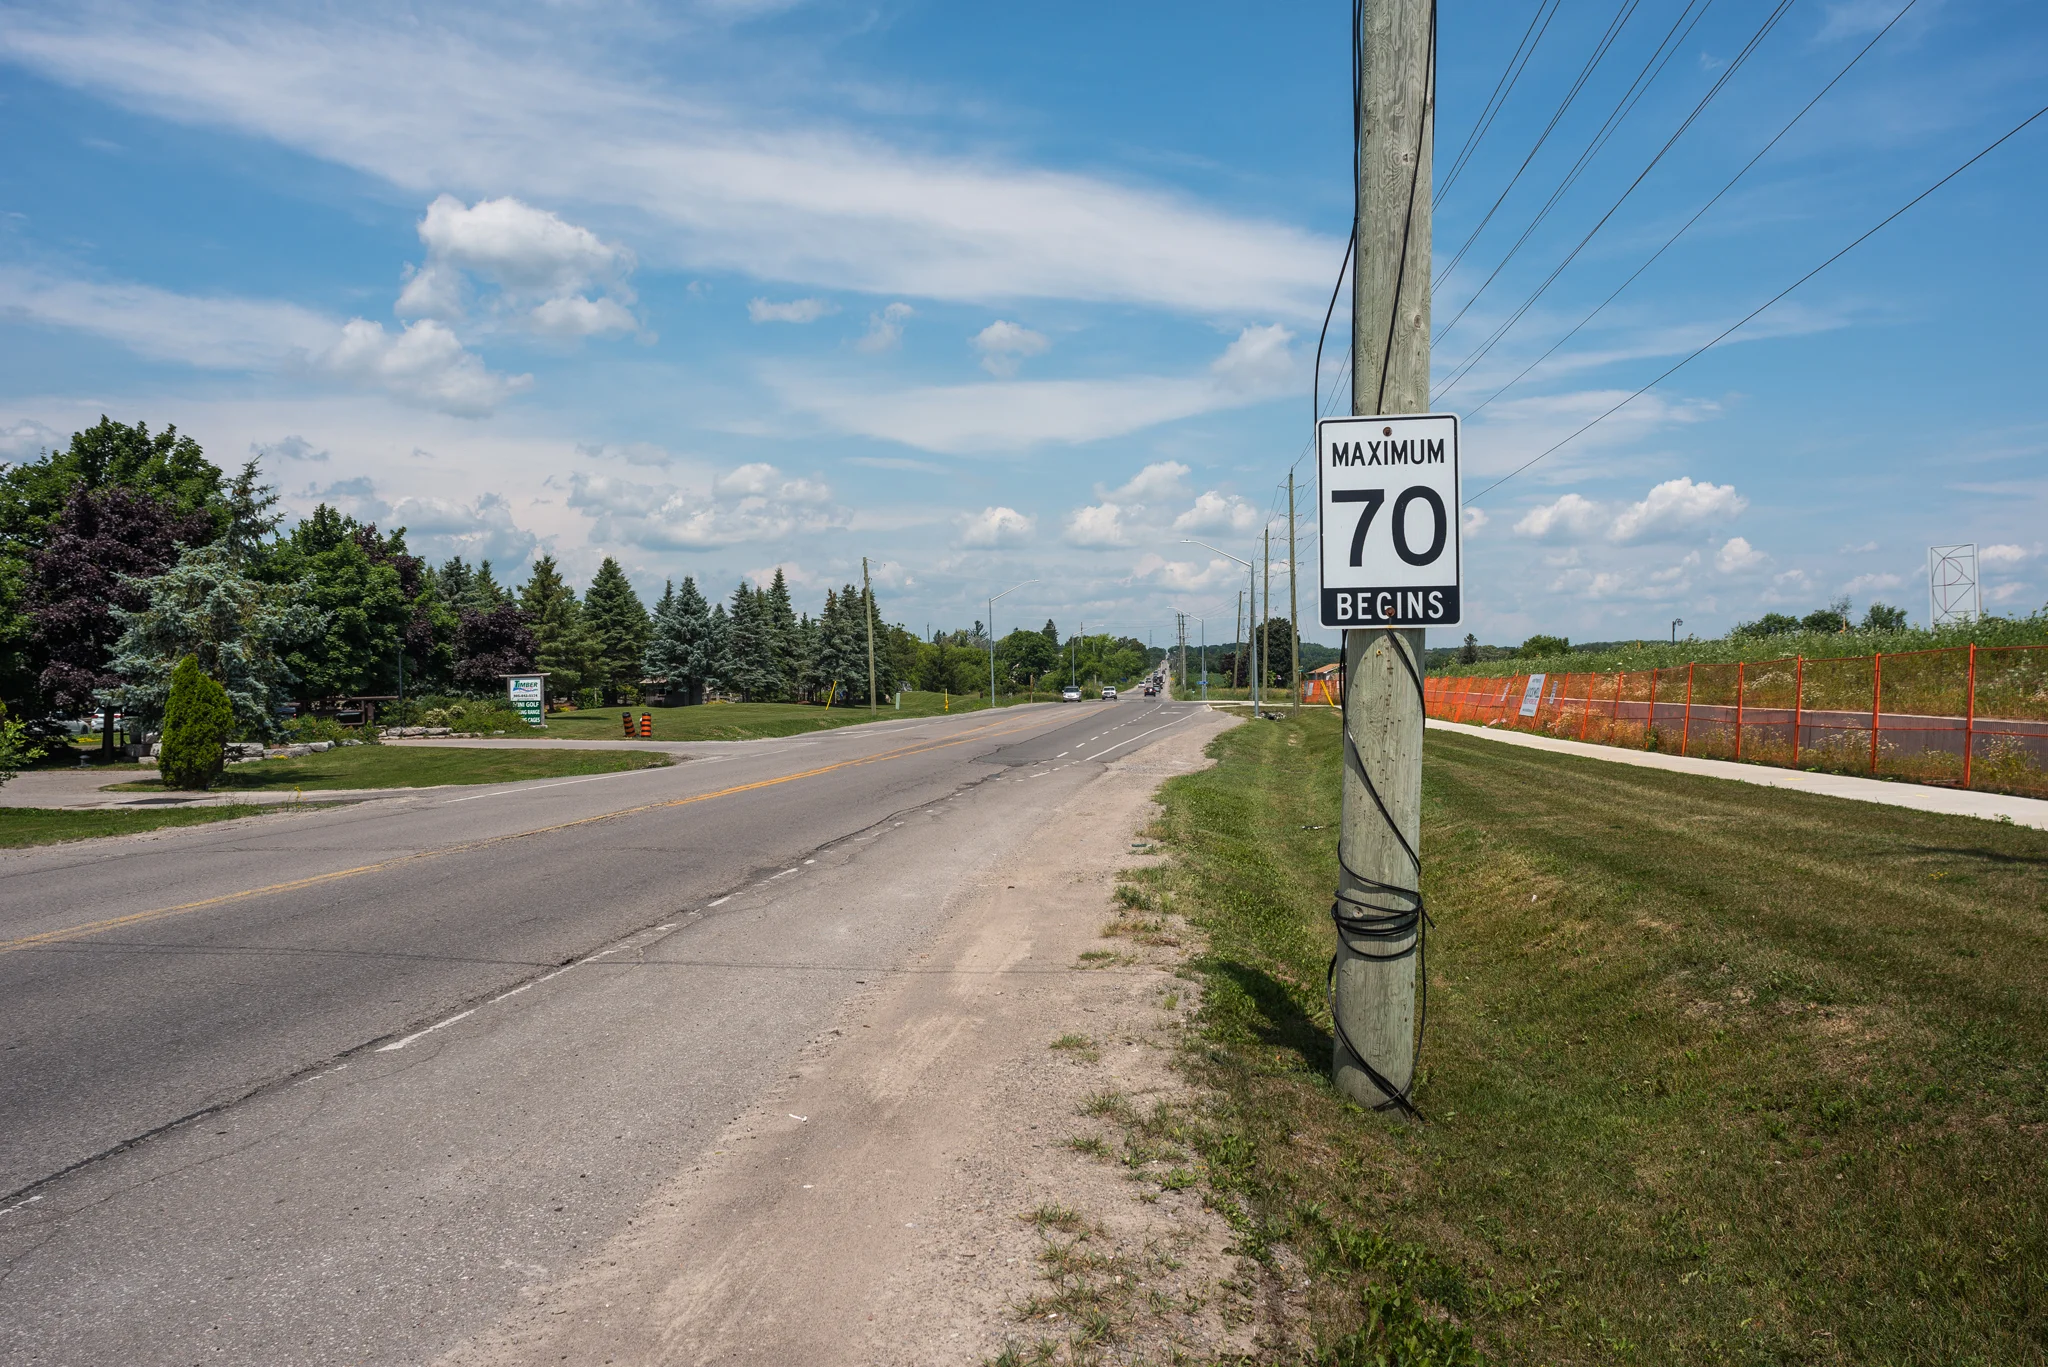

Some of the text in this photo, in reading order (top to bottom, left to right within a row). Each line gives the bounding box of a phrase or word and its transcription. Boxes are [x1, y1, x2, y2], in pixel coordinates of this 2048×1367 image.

[1332, 438, 1445, 467] MAXIMUM
[1331, 485, 1447, 567] 70
[1336, 591, 1444, 620] BEGINS
